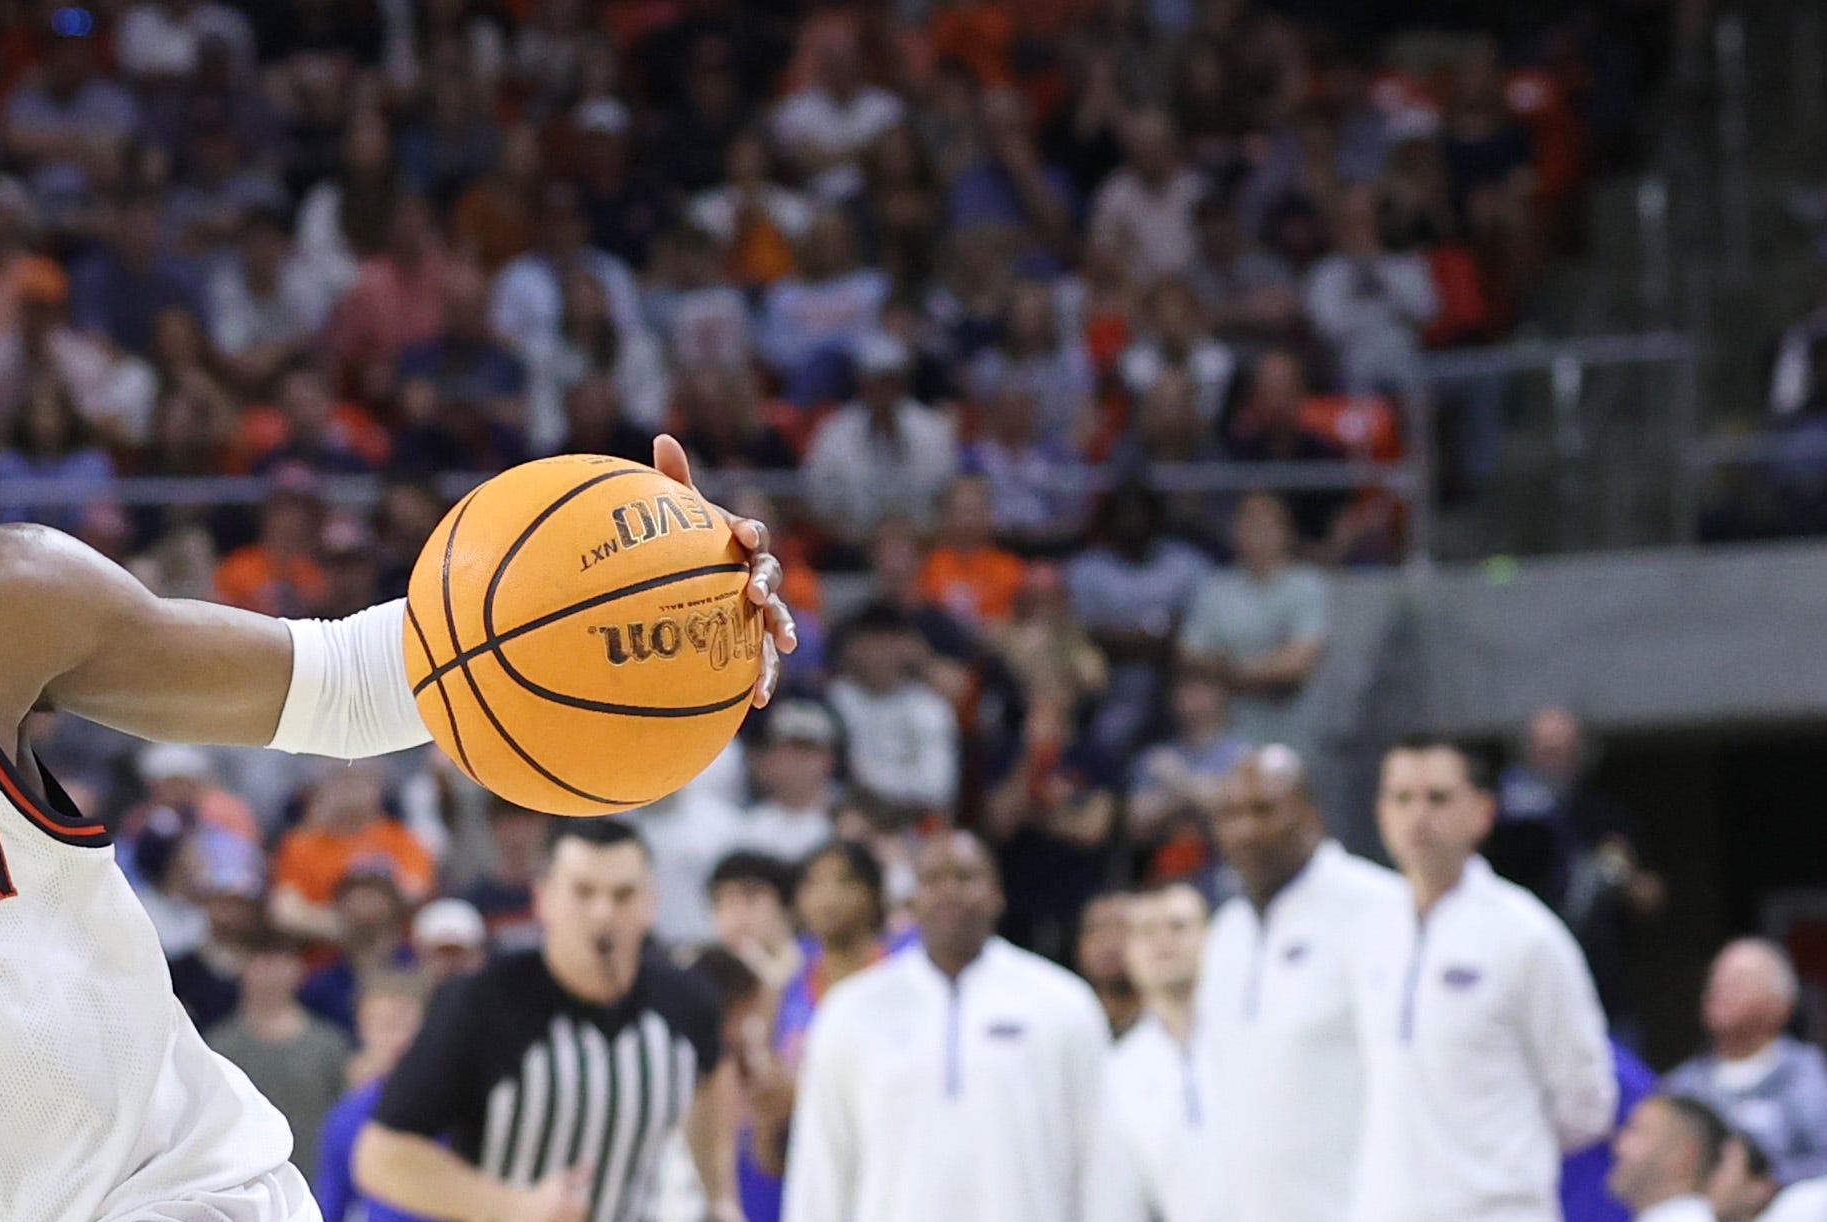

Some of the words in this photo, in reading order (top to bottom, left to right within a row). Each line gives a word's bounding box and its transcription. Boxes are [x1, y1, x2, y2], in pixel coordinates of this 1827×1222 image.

[612, 492, 715, 550] EVO
[580, 538, 619, 573] NXT
[659, 603, 684, 613] BALL
